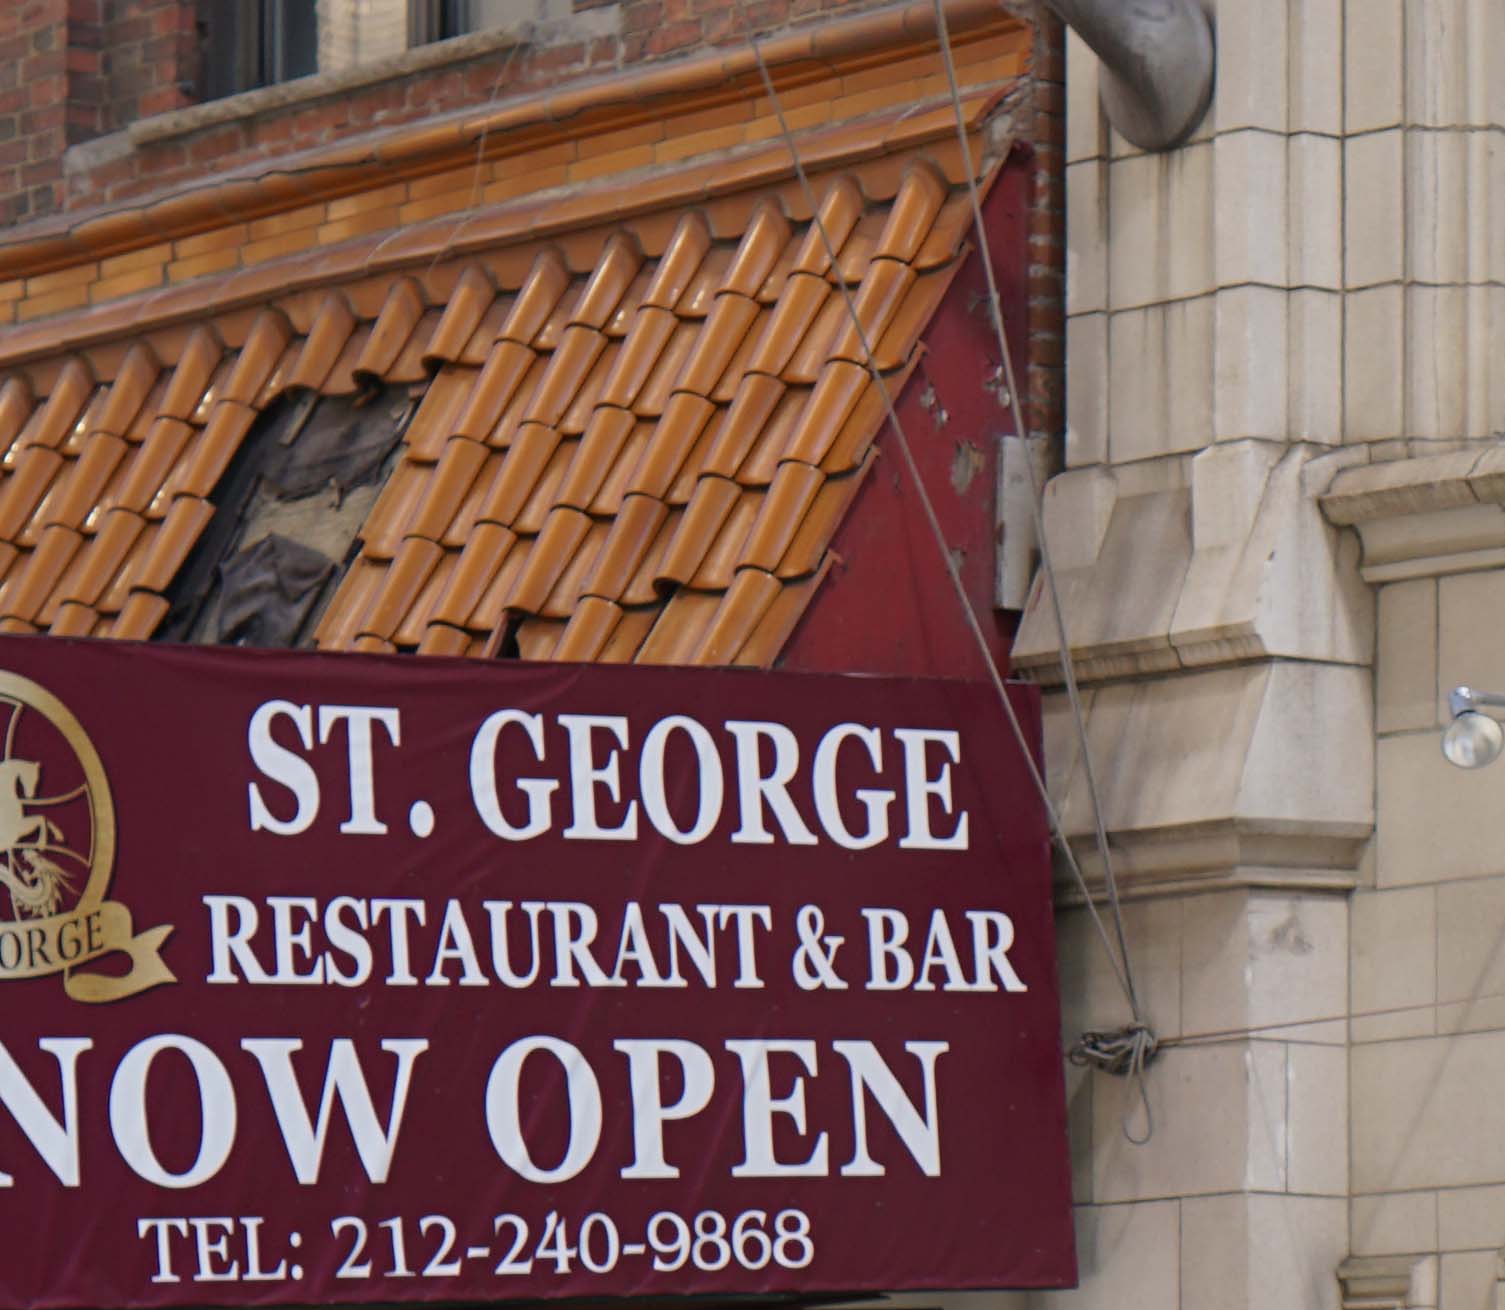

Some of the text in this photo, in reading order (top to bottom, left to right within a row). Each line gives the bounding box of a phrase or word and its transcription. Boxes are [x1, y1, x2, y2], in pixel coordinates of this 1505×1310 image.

[247, 699, 971, 850] ST. GEORGE
[203, 895, 1028, 993] RESTAURANT & BAR
[0, 1033, 950, 1190] NOW OPEN
[139, 1208, 814, 1285] TEL: 212-240-9868
